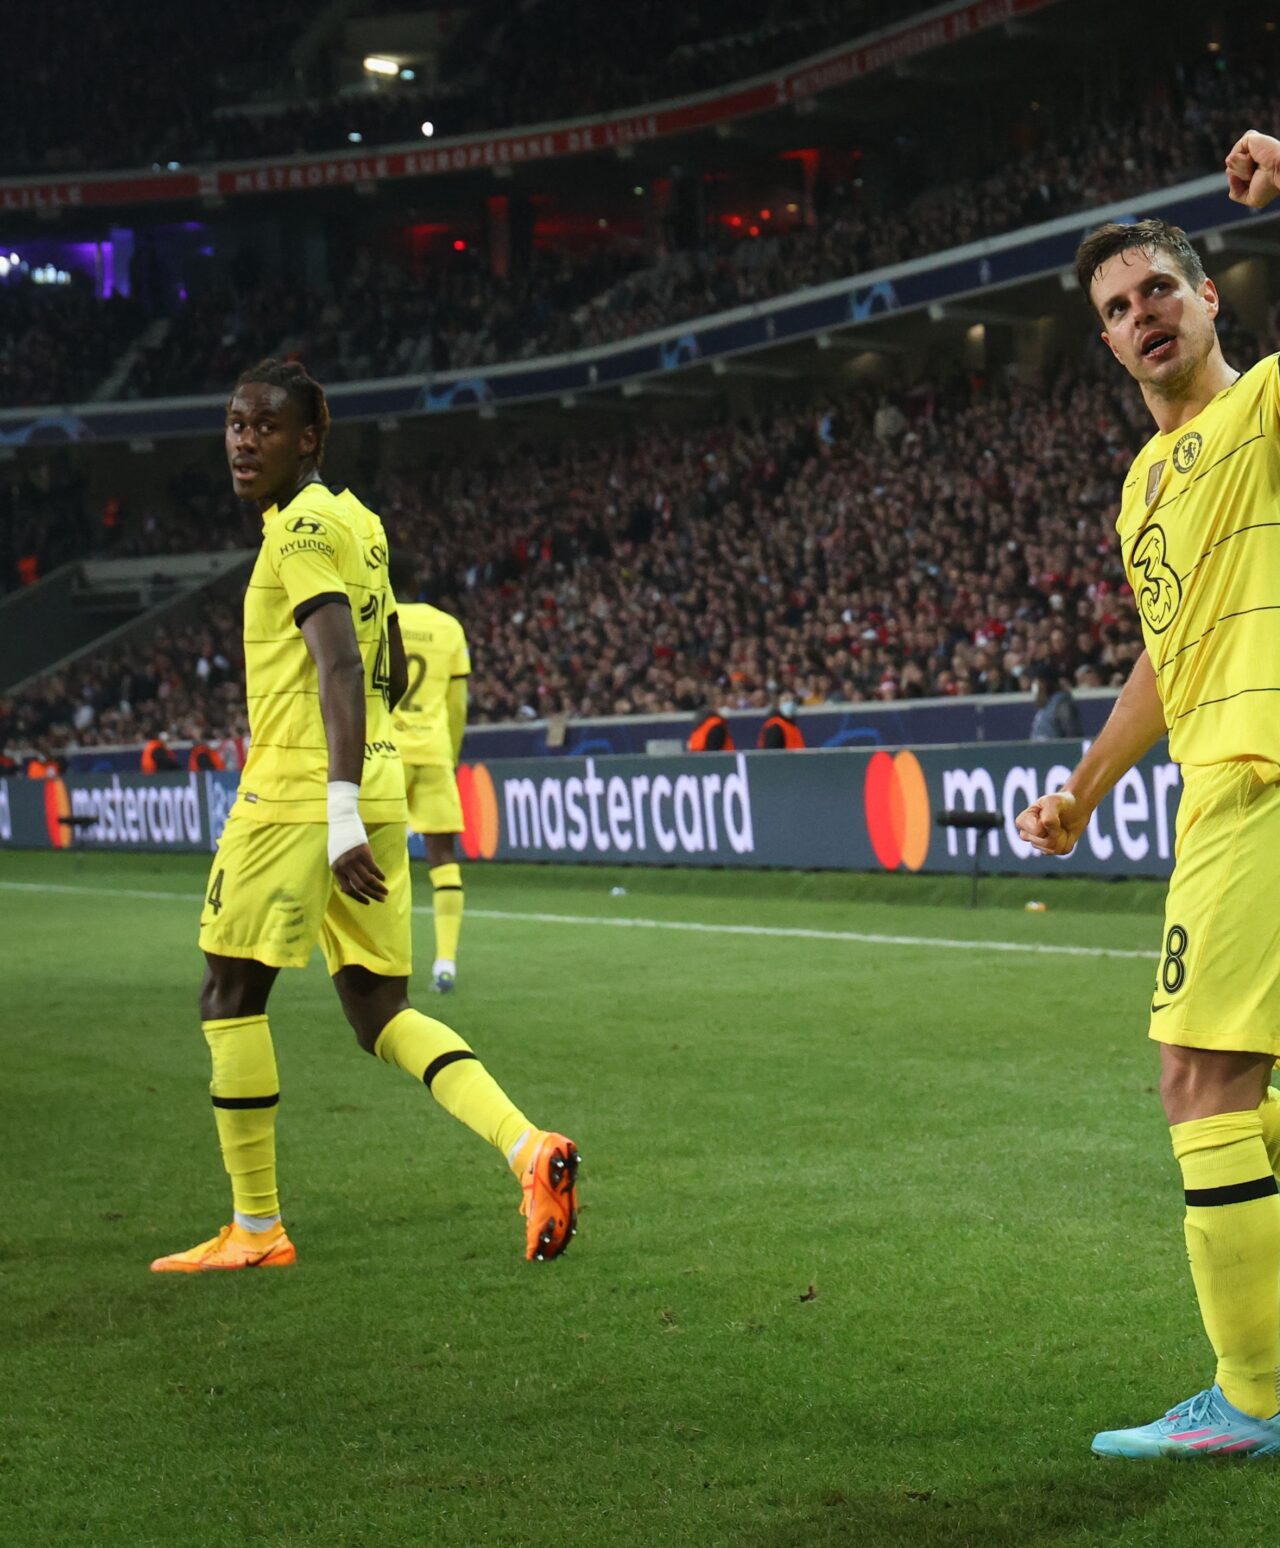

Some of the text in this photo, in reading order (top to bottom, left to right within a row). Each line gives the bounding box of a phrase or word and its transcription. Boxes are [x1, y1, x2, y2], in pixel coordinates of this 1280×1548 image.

[398, 653, 427, 712] 2
[71, 772, 201, 843] mastercard
[504, 752, 754, 854] mastercard
